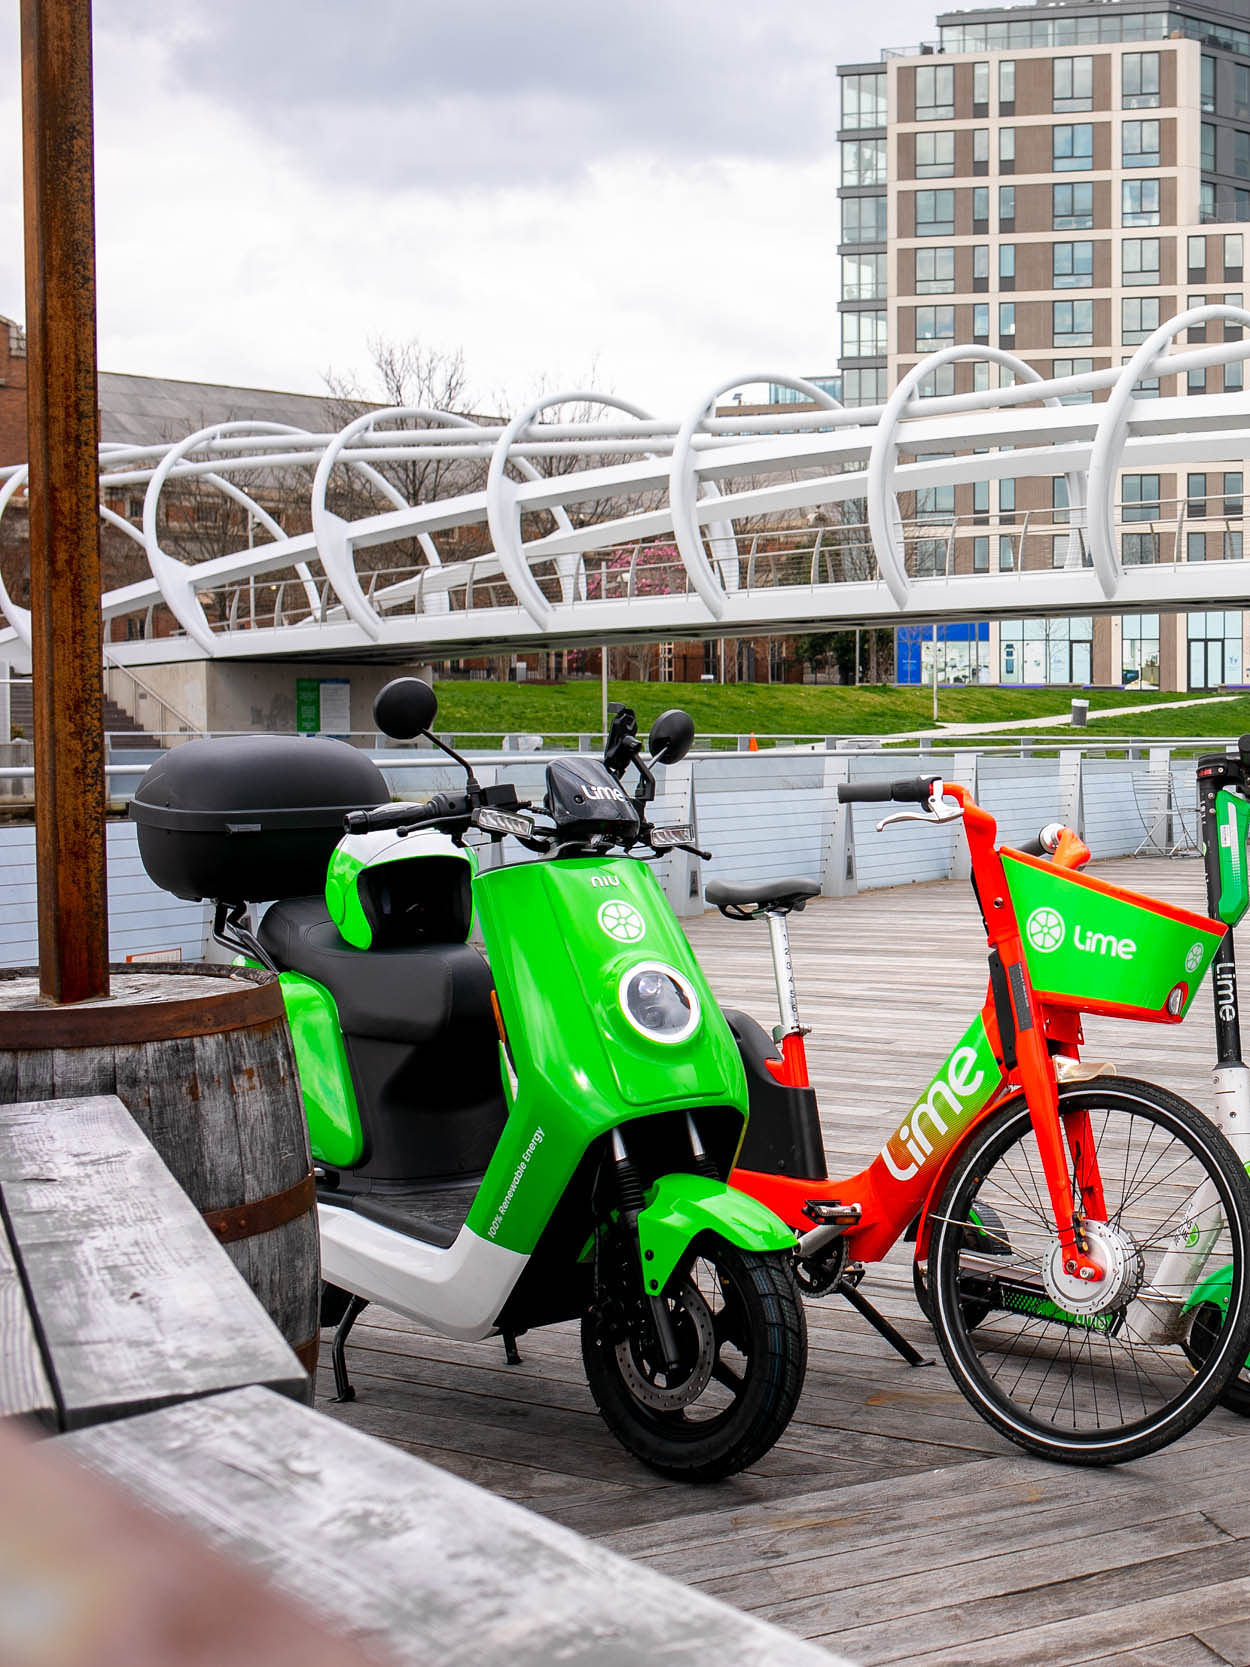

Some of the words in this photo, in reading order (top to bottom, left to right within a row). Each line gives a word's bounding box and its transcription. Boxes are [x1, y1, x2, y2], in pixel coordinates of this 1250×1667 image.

[581, 785, 625, 802] Lime
[784, 947, 790, 956] 2
[1074, 925, 1137, 960] Lime
[1216, 962, 1236, 1022] Lime
[880, 1046, 985, 1181] Lime
[488, 1214, 503, 1239] 100%
[498, 1161, 527, 1215] Renewable
[522, 1126, 545, 1162] Energy
